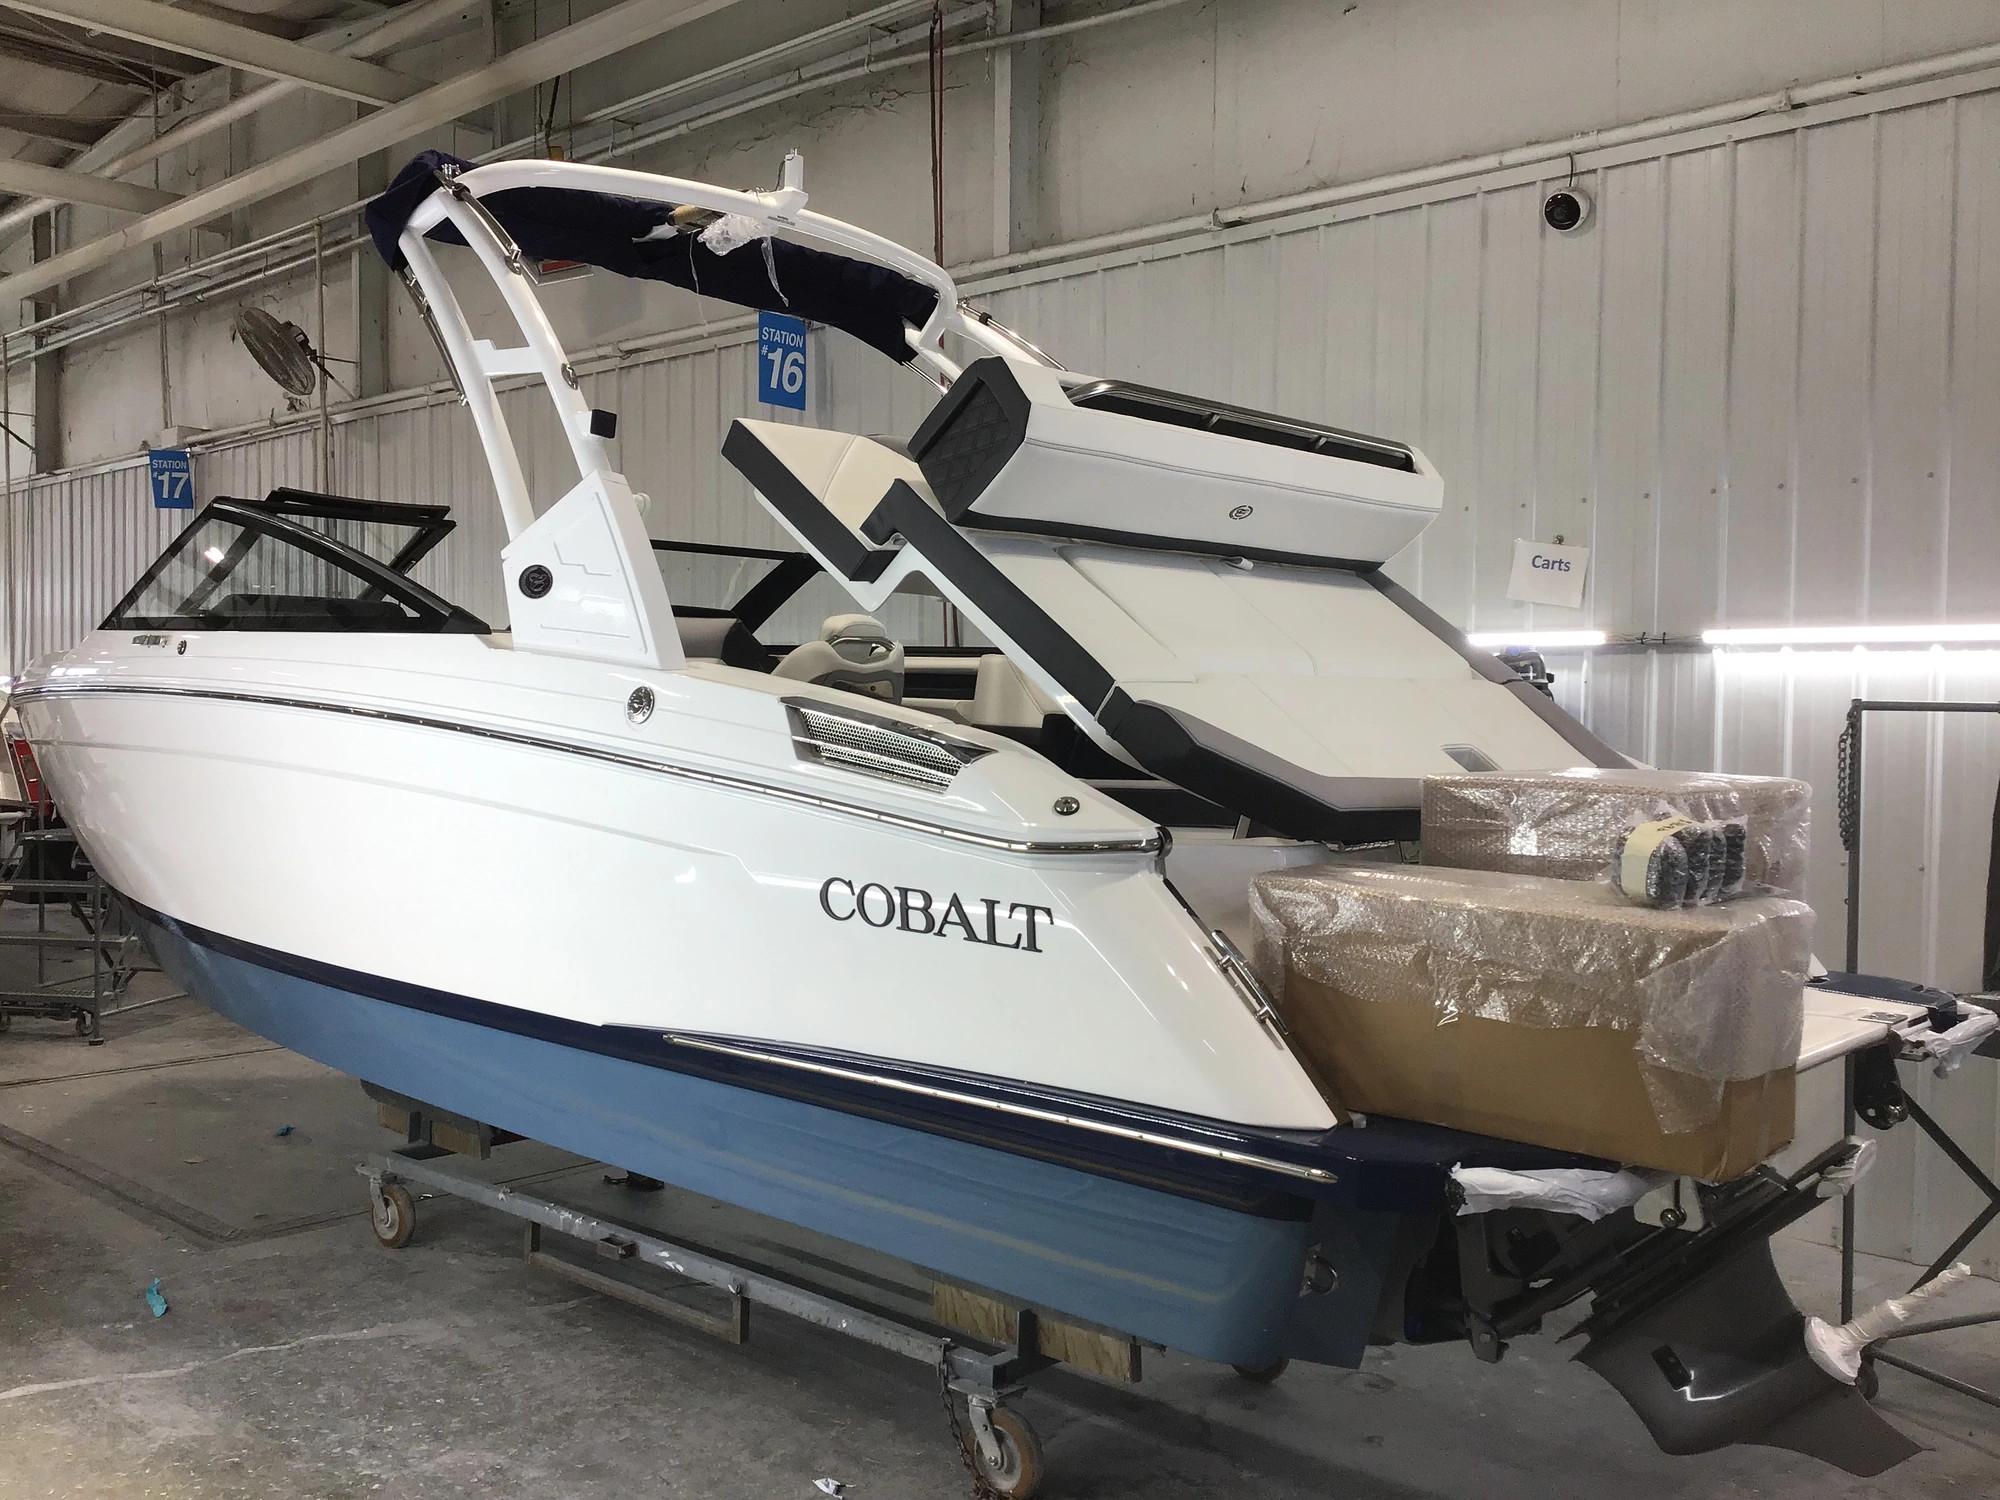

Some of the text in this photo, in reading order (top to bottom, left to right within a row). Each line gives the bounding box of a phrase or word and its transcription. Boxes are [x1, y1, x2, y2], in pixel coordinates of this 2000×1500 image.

[762, 327, 804, 348] STATION
[152, 459, 187, 469] STATION
[1531, 555, 1571, 572] Carts
[819, 877, 1054, 953] COBALT
